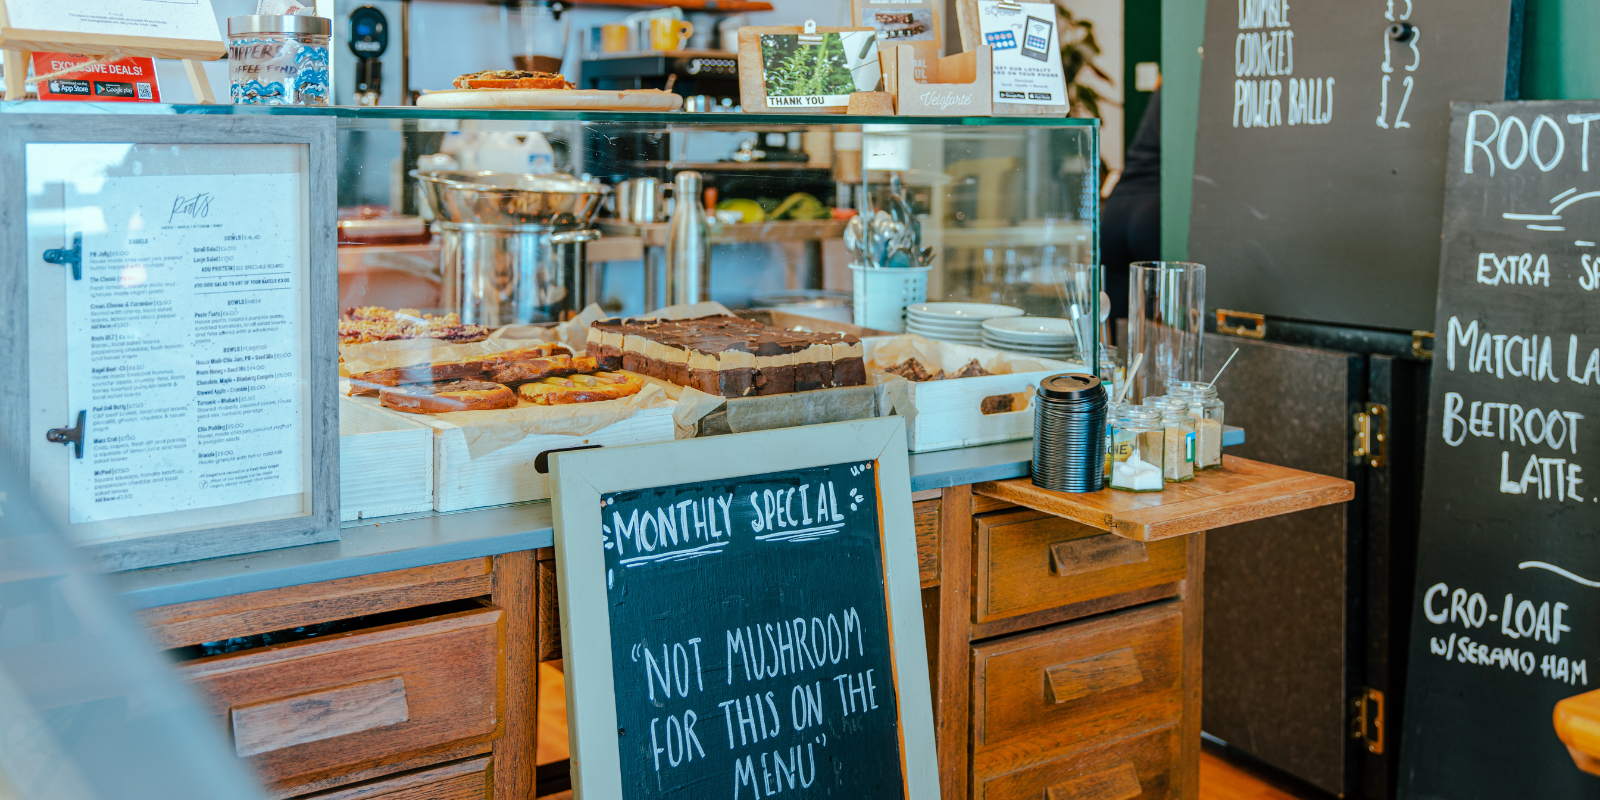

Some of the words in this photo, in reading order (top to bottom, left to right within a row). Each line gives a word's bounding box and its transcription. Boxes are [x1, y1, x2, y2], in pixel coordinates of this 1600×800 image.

[108, 64, 143, 76] DEALS!
[1235, 30, 1294, 77] COOKIES
[61, 85, 73, 93] App
[769, 97, 802, 105] THANK
[805, 96, 824, 104] YOU
[1233, 78, 1282, 128] POWER
[1288, 77, 1334, 126] BALLS
[169, 192, 215, 224] Roots
[1477, 252, 1550, 288] EXTRA
[1446, 316, 1560, 383] MATCHA
[1442, 392, 1584, 454] BEETROOT
[612, 492, 734, 555] MONTHLY
[750, 480, 845, 533] SPECIAL
[1423, 582, 1571, 645] CRO-LOAF
[726, 606, 862, 686] MUSHROOM
[1540, 654, 1587, 686] HAM
[650, 708, 706, 772] FOR
[718, 690, 780, 750] THIS
[791, 680, 823, 731] ON
[833, 668, 879, 717] THE
